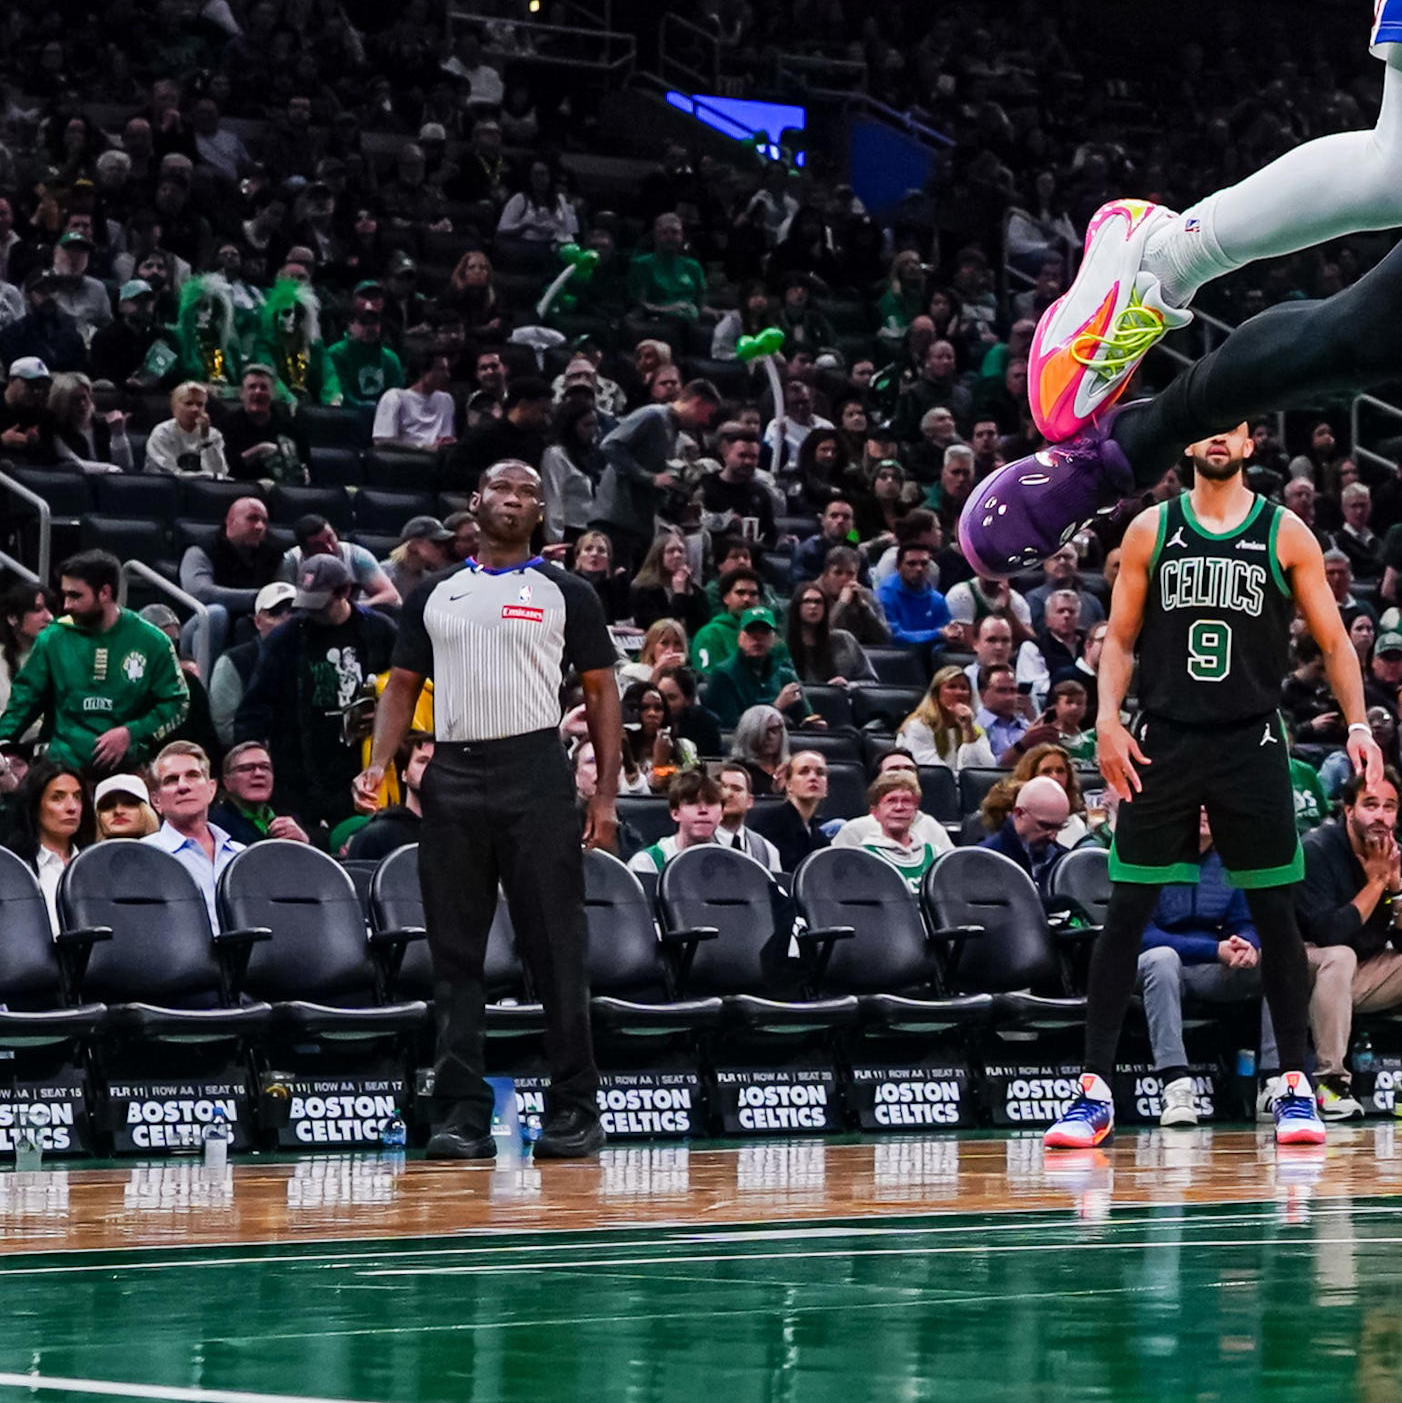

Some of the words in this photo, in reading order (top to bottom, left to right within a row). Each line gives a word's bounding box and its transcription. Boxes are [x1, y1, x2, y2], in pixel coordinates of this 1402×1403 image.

[1160, 557, 1267, 617] CELTICS
[1187, 619, 1232, 682] 9
[109, 1086, 131, 1098] FLR
[152, 1085, 178, 1097] ROW
[180, 1085, 195, 1096] AA
[205, 1085, 231, 1096] SEAT
[314, 1082, 339, 1093] ROW
[340, 1081, 355, 1092] AA
[364, 1081, 389, 1092] SEAT
[126, 1099, 239, 1124] BOSTON
[289, 1095, 396, 1120] BOSTON
[738, 1106, 828, 1129] CELTICS
[874, 1103, 960, 1126] CELTICS
[599, 1110, 692, 1134] CELTICS
